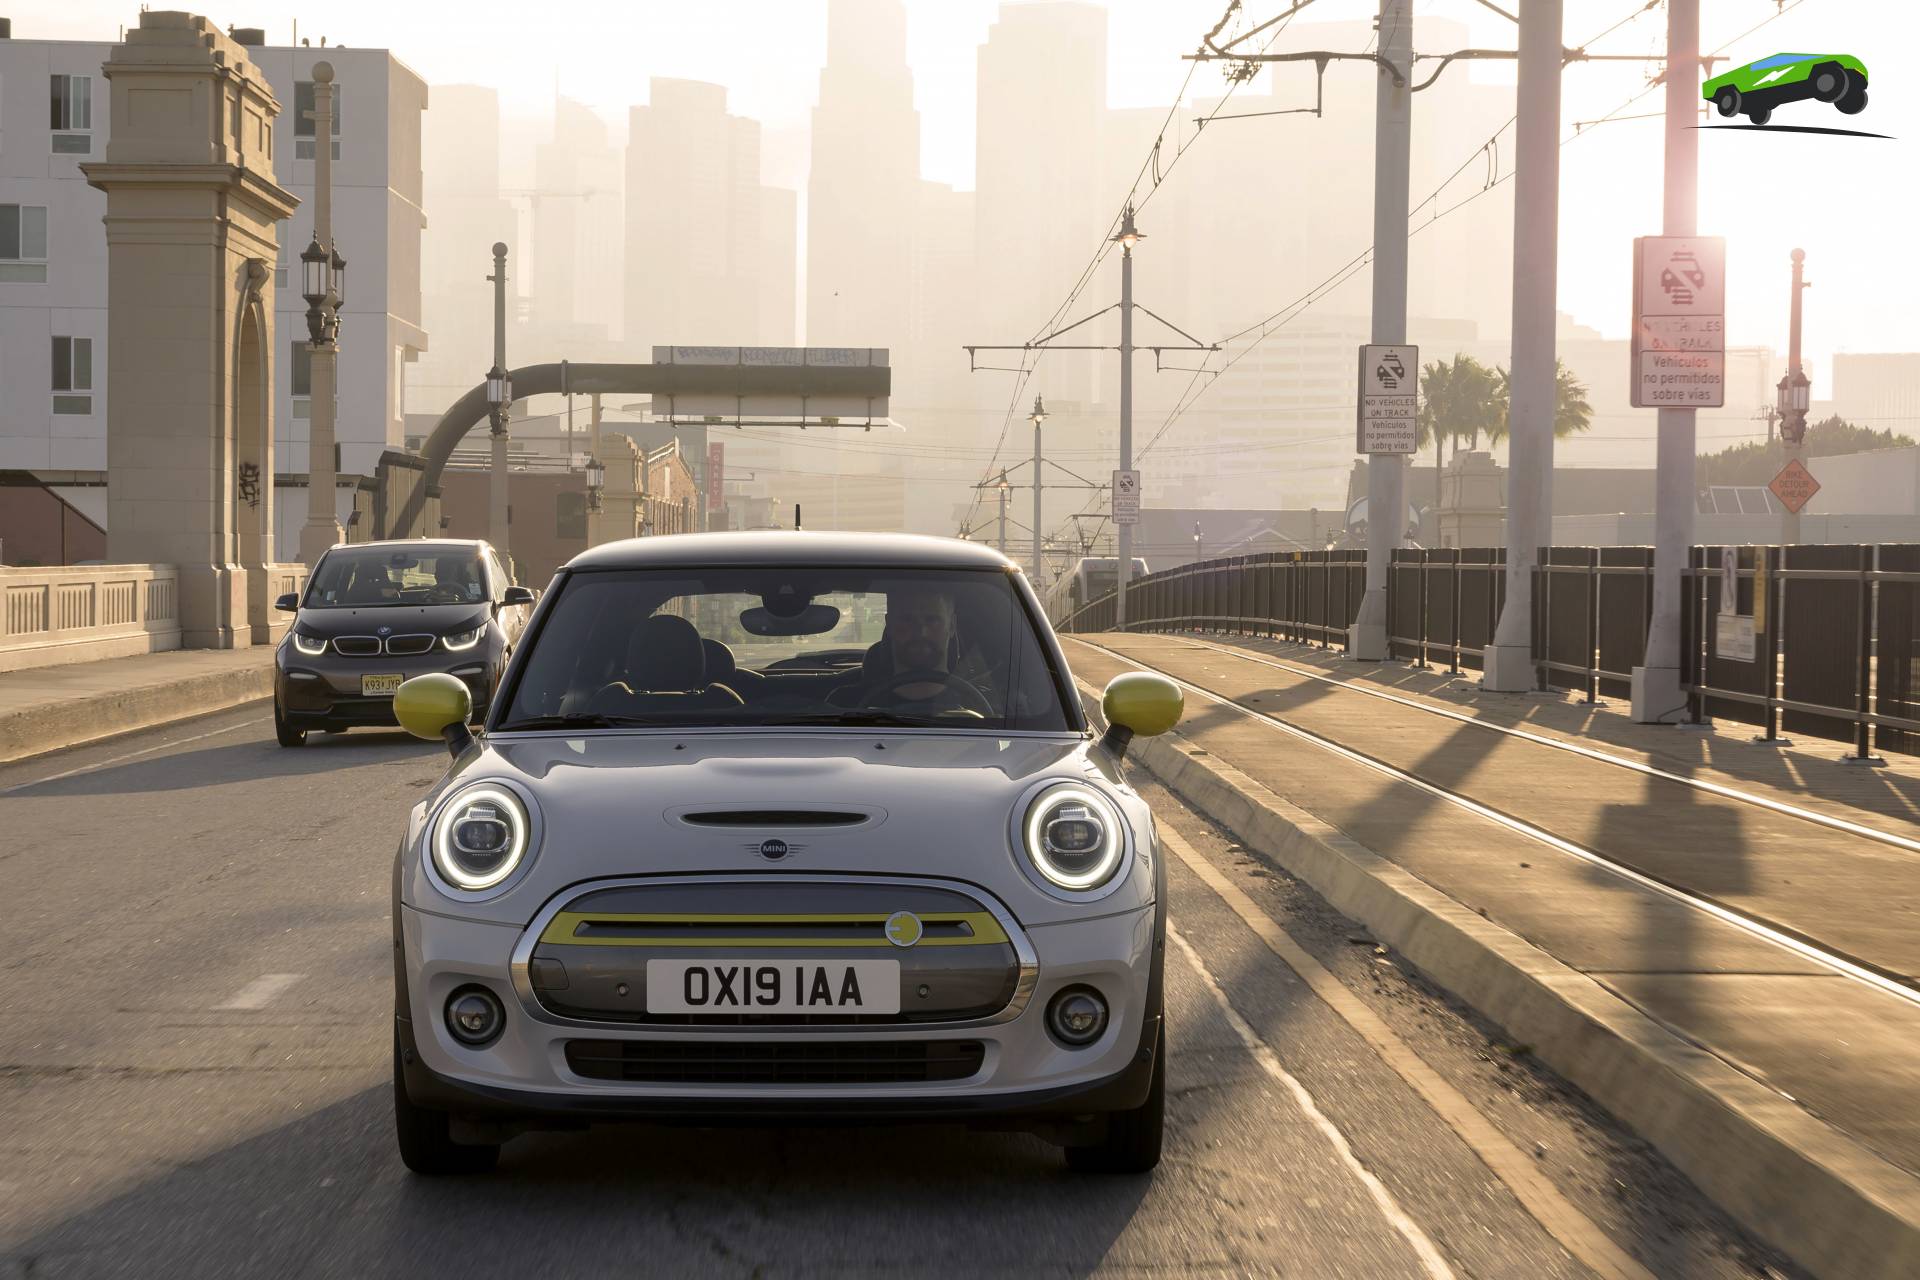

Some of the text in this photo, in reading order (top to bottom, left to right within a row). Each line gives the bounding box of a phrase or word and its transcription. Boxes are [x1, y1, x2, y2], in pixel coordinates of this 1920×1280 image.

[1663, 320, 1721, 332] EHLES
[1653, 354, 1708, 368] Vehículos
[1643, 372, 1721, 386] no permitidos
[1652, 388, 1685, 400] sobre
[1378, 398, 1416, 406] VEHICLES
[1370, 409, 1409, 417] ON TRACK
[683, 966, 863, 1006] OX19 IAA
